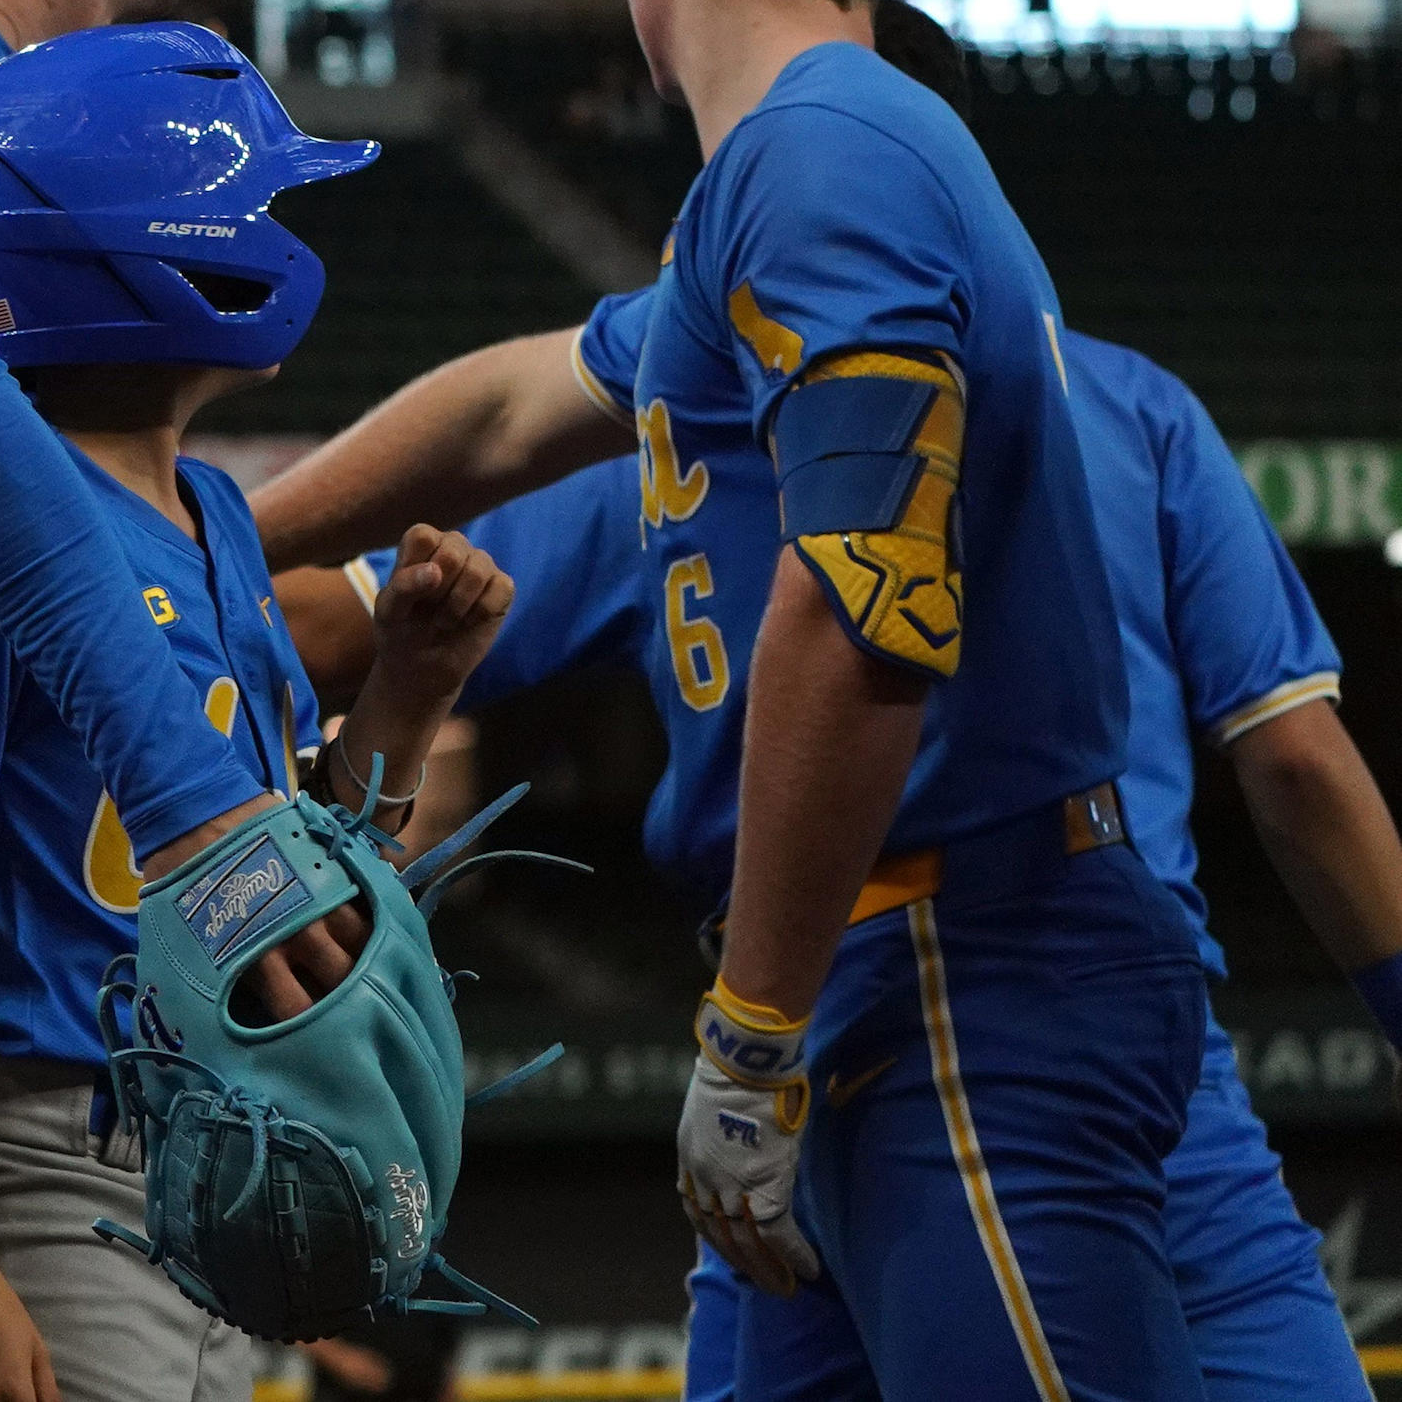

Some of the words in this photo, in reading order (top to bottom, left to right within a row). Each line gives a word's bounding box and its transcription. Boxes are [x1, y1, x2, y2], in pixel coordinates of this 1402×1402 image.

[147, 222, 237, 238] EASTON
[663, 553, 729, 713] 6
[204, 858, 284, 939] Rawlings
